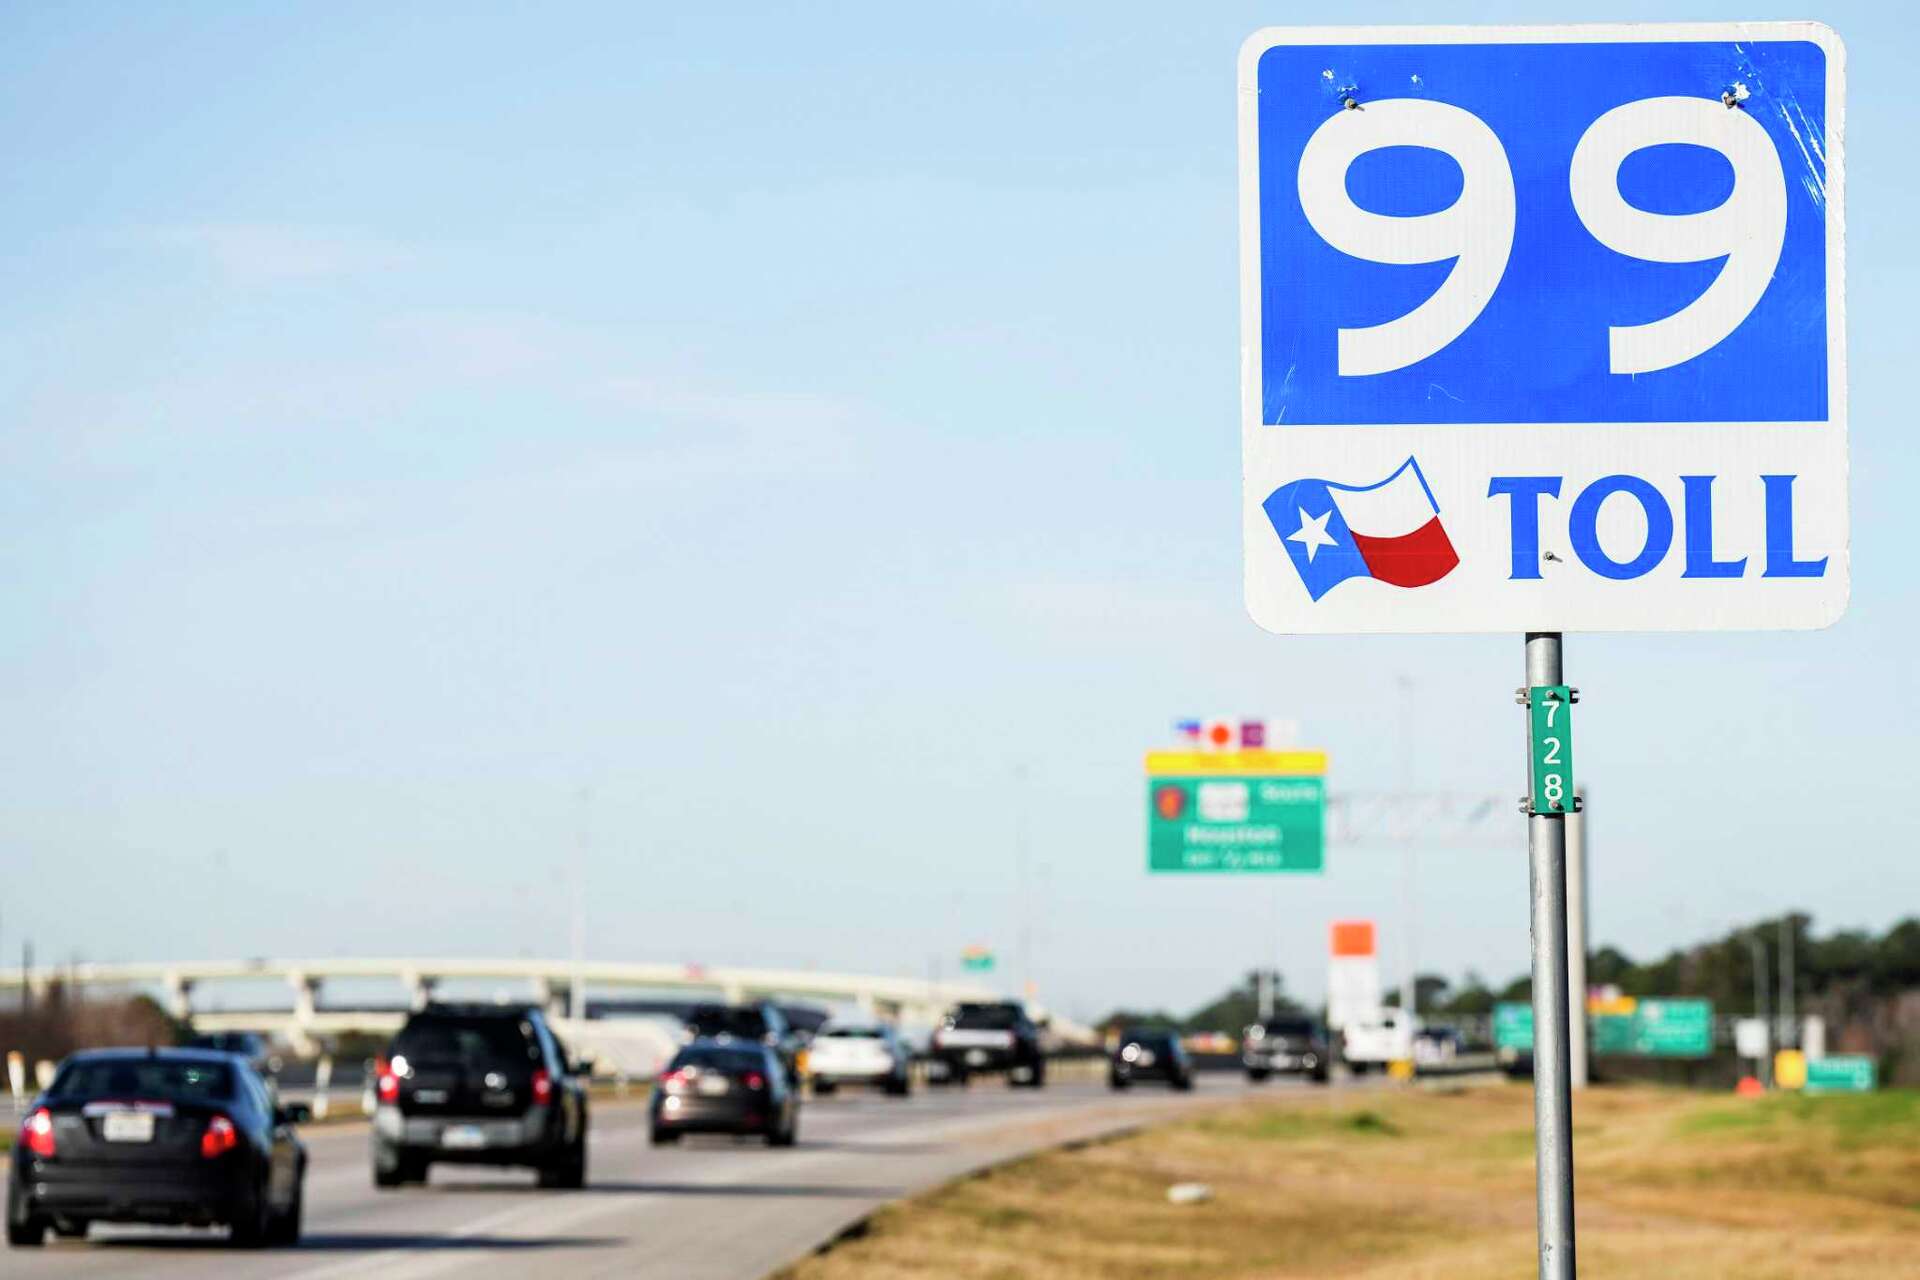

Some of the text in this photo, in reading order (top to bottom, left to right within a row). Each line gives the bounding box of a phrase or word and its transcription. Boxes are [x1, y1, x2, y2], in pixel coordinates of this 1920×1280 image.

[1297, 96, 1788, 376] 99
[1487, 474, 1829, 580] TOLL
[1542, 701, 1563, 800] 728
